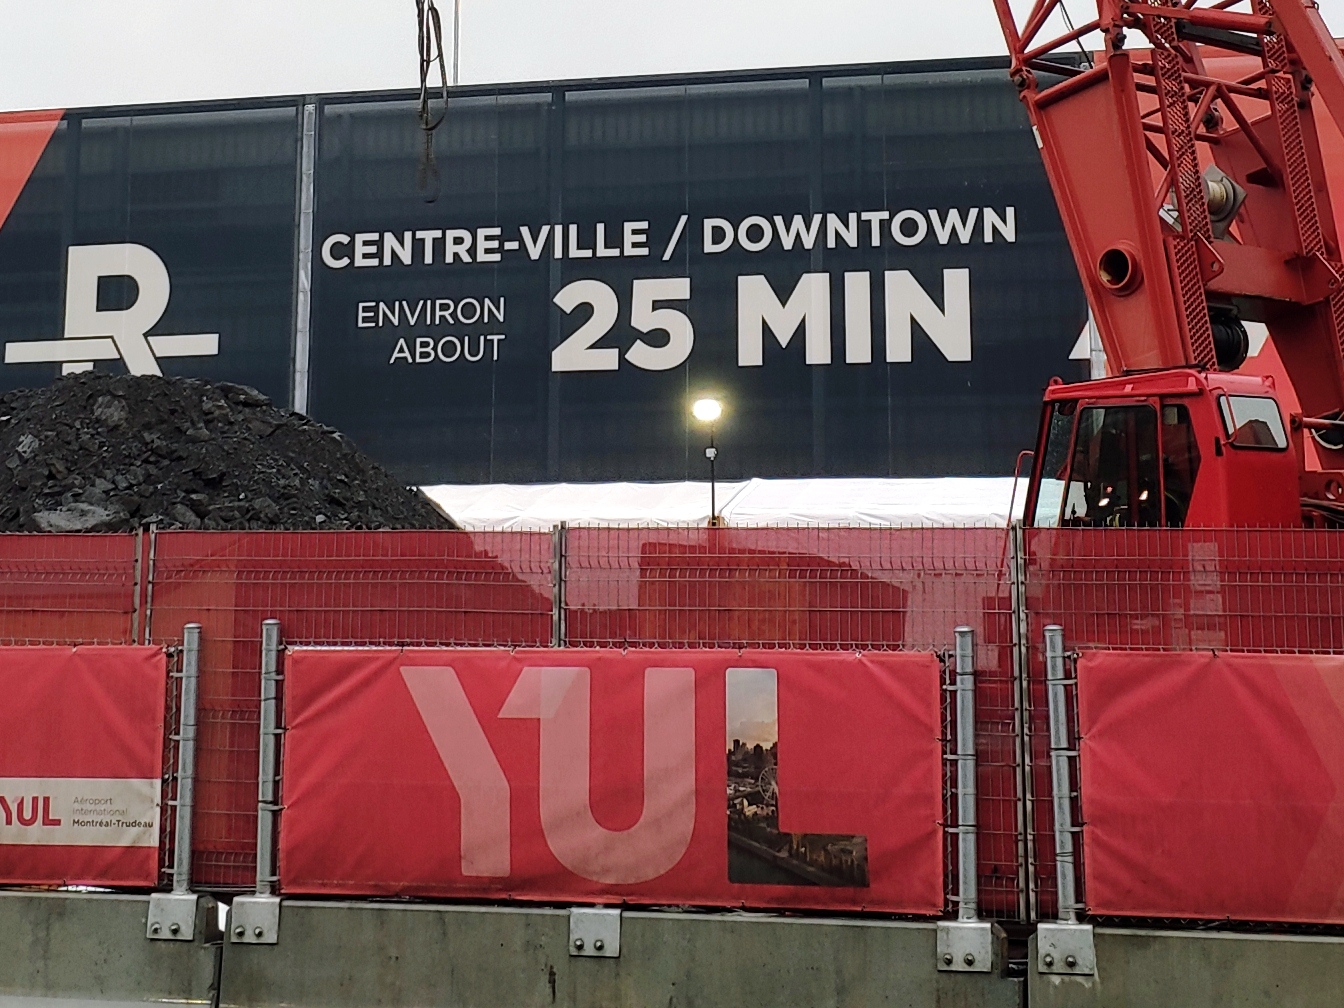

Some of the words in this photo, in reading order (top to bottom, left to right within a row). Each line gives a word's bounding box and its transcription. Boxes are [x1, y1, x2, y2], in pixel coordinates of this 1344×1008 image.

[321, 220, 649, 269] CENTRE-VILLE
[703, 206, 1016, 254] DOWNTOWN
[357, 296, 505, 328] ENVIRON
[551, 276, 695, 373] 25
[737, 267, 972, 367] MIN
[389, 334, 505, 364] ABOUT
[398, 665, 870, 889] YUL
[72, 796, 113, 807] Aéroport
[72, 818, 154, 829] Montréal-Trudeau
